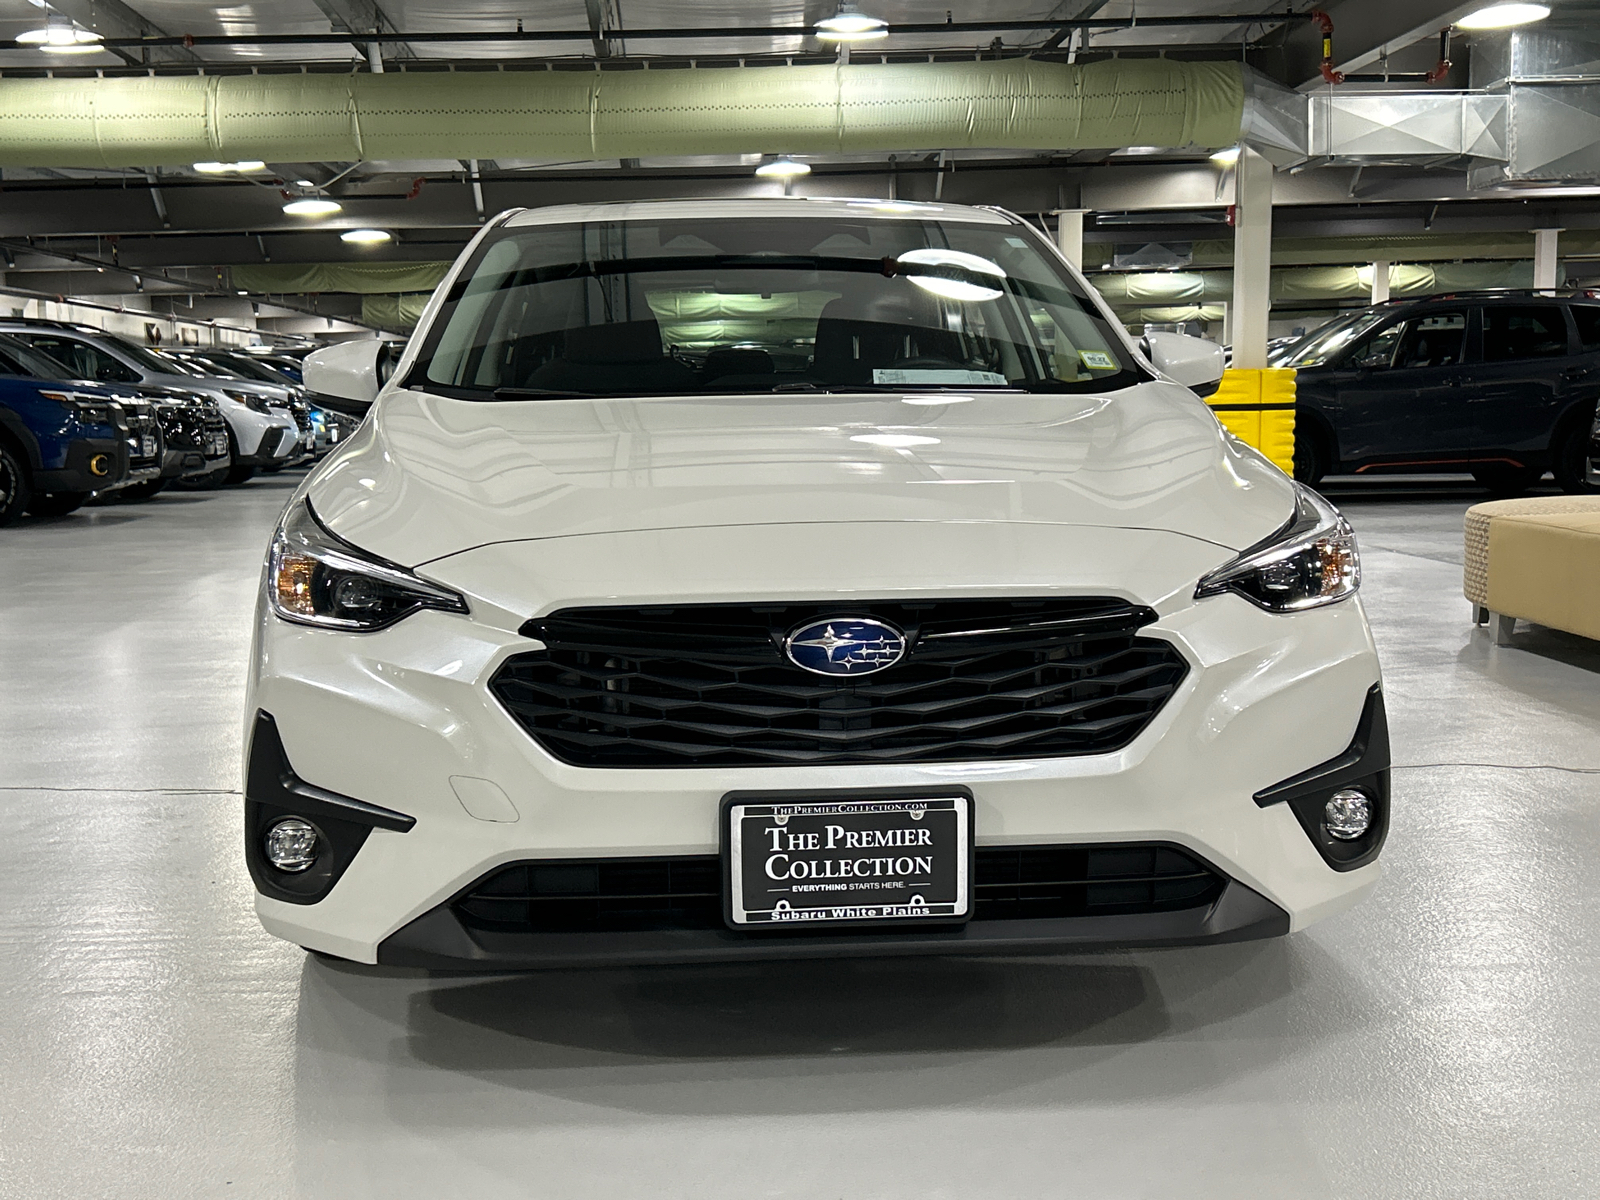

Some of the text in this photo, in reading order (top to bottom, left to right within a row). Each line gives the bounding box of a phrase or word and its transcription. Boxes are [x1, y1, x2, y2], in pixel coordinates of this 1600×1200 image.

[792, 884, 848, 892] EVERYTHING
[881, 881, 906, 889] HERE.
[771, 906, 930, 921] Subaru White Plains
